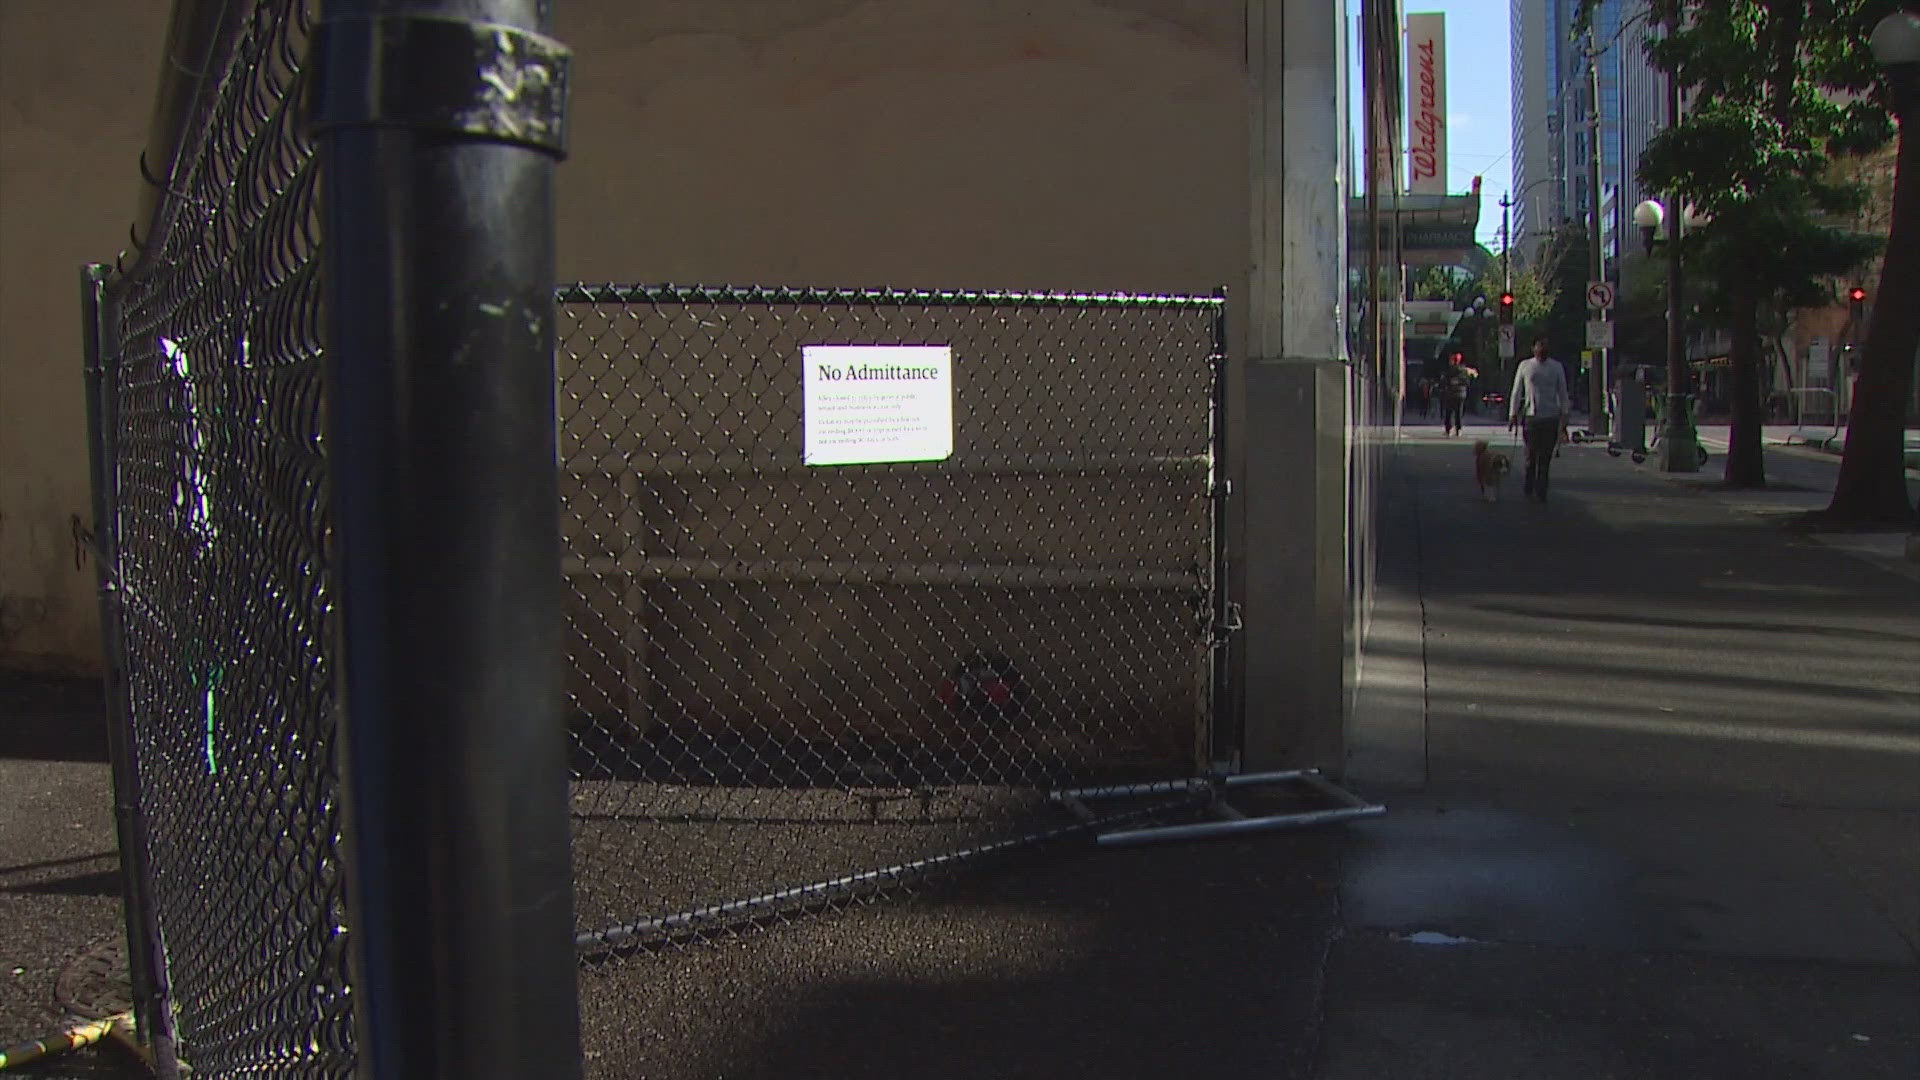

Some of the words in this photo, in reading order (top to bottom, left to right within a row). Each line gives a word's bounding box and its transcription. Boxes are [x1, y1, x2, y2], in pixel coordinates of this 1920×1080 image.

[1412, 39, 1443, 181] Walgreens
[818, 364, 841, 381] No
[846, 363, 938, 380] Admittance
